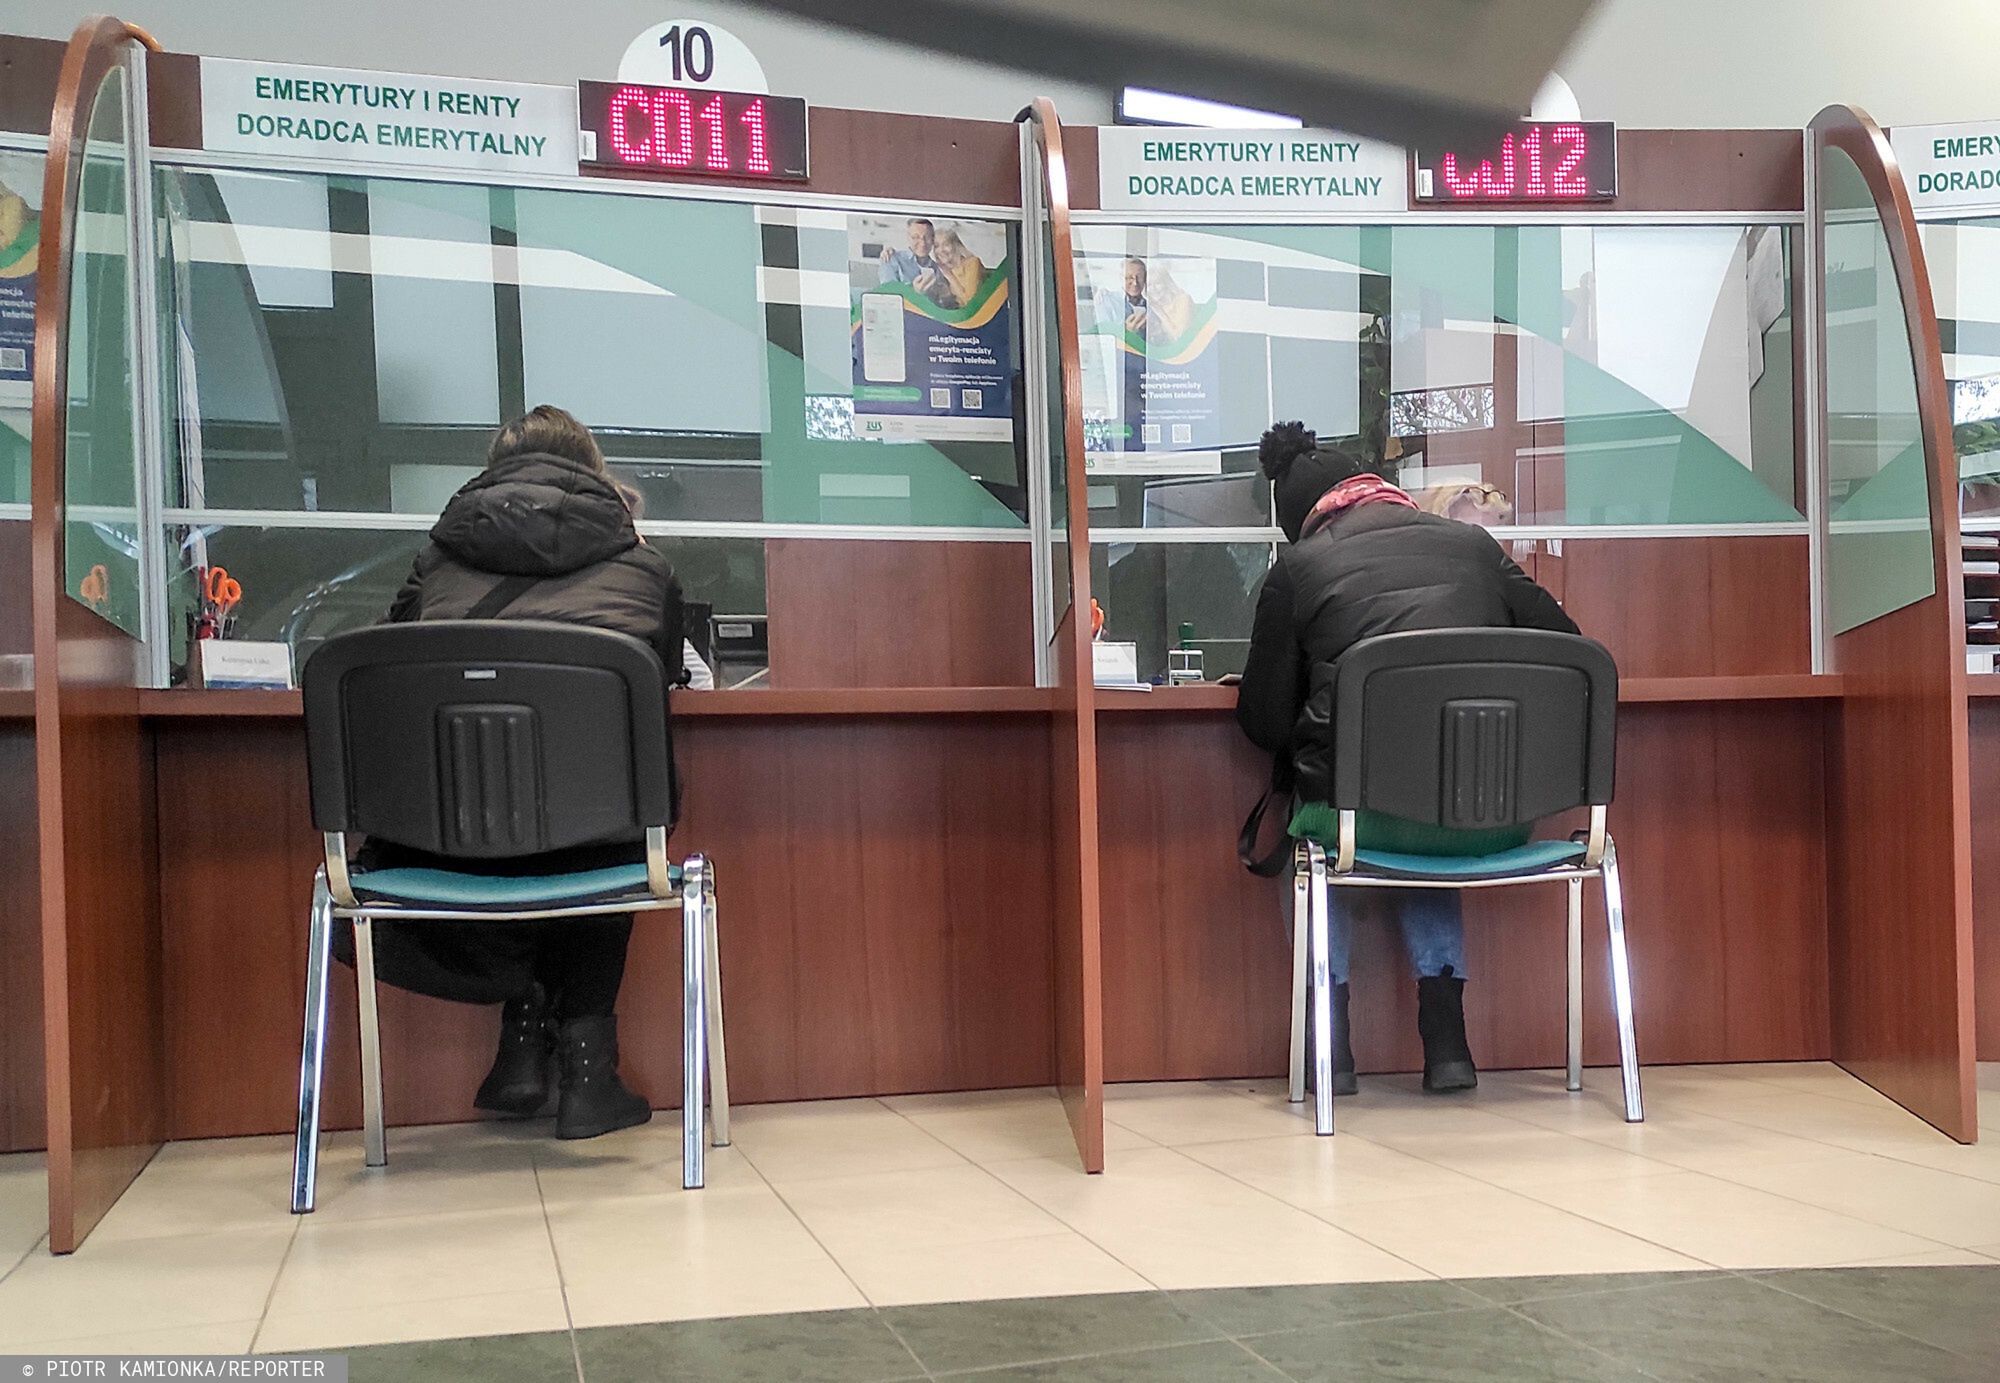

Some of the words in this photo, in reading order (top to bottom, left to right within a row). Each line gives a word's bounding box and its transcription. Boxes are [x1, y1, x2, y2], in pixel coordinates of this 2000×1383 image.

[659, 25, 714, 83] 10
[255, 76, 415, 110] EMERYTURY
[423, 90, 430, 112] I
[438, 91, 521, 119] RENTY
[237, 112, 369, 144] DORADCA
[376, 123, 547, 158] EMERYTALNY
[612, 88, 769, 171] C011
[1143, 142, 1273, 163] EMERYTURY
[1279, 143, 1285, 163] I
[1291, 142, 1361, 163] RENTY
[1128, 176, 1235, 196] DORADCA
[1241, 176, 1382, 197] EMERYTALNY
[1918, 169, 2000, 194] DORAD
[938, 355, 963, 364] Twoim
[964, 357, 997, 365] telefonie
